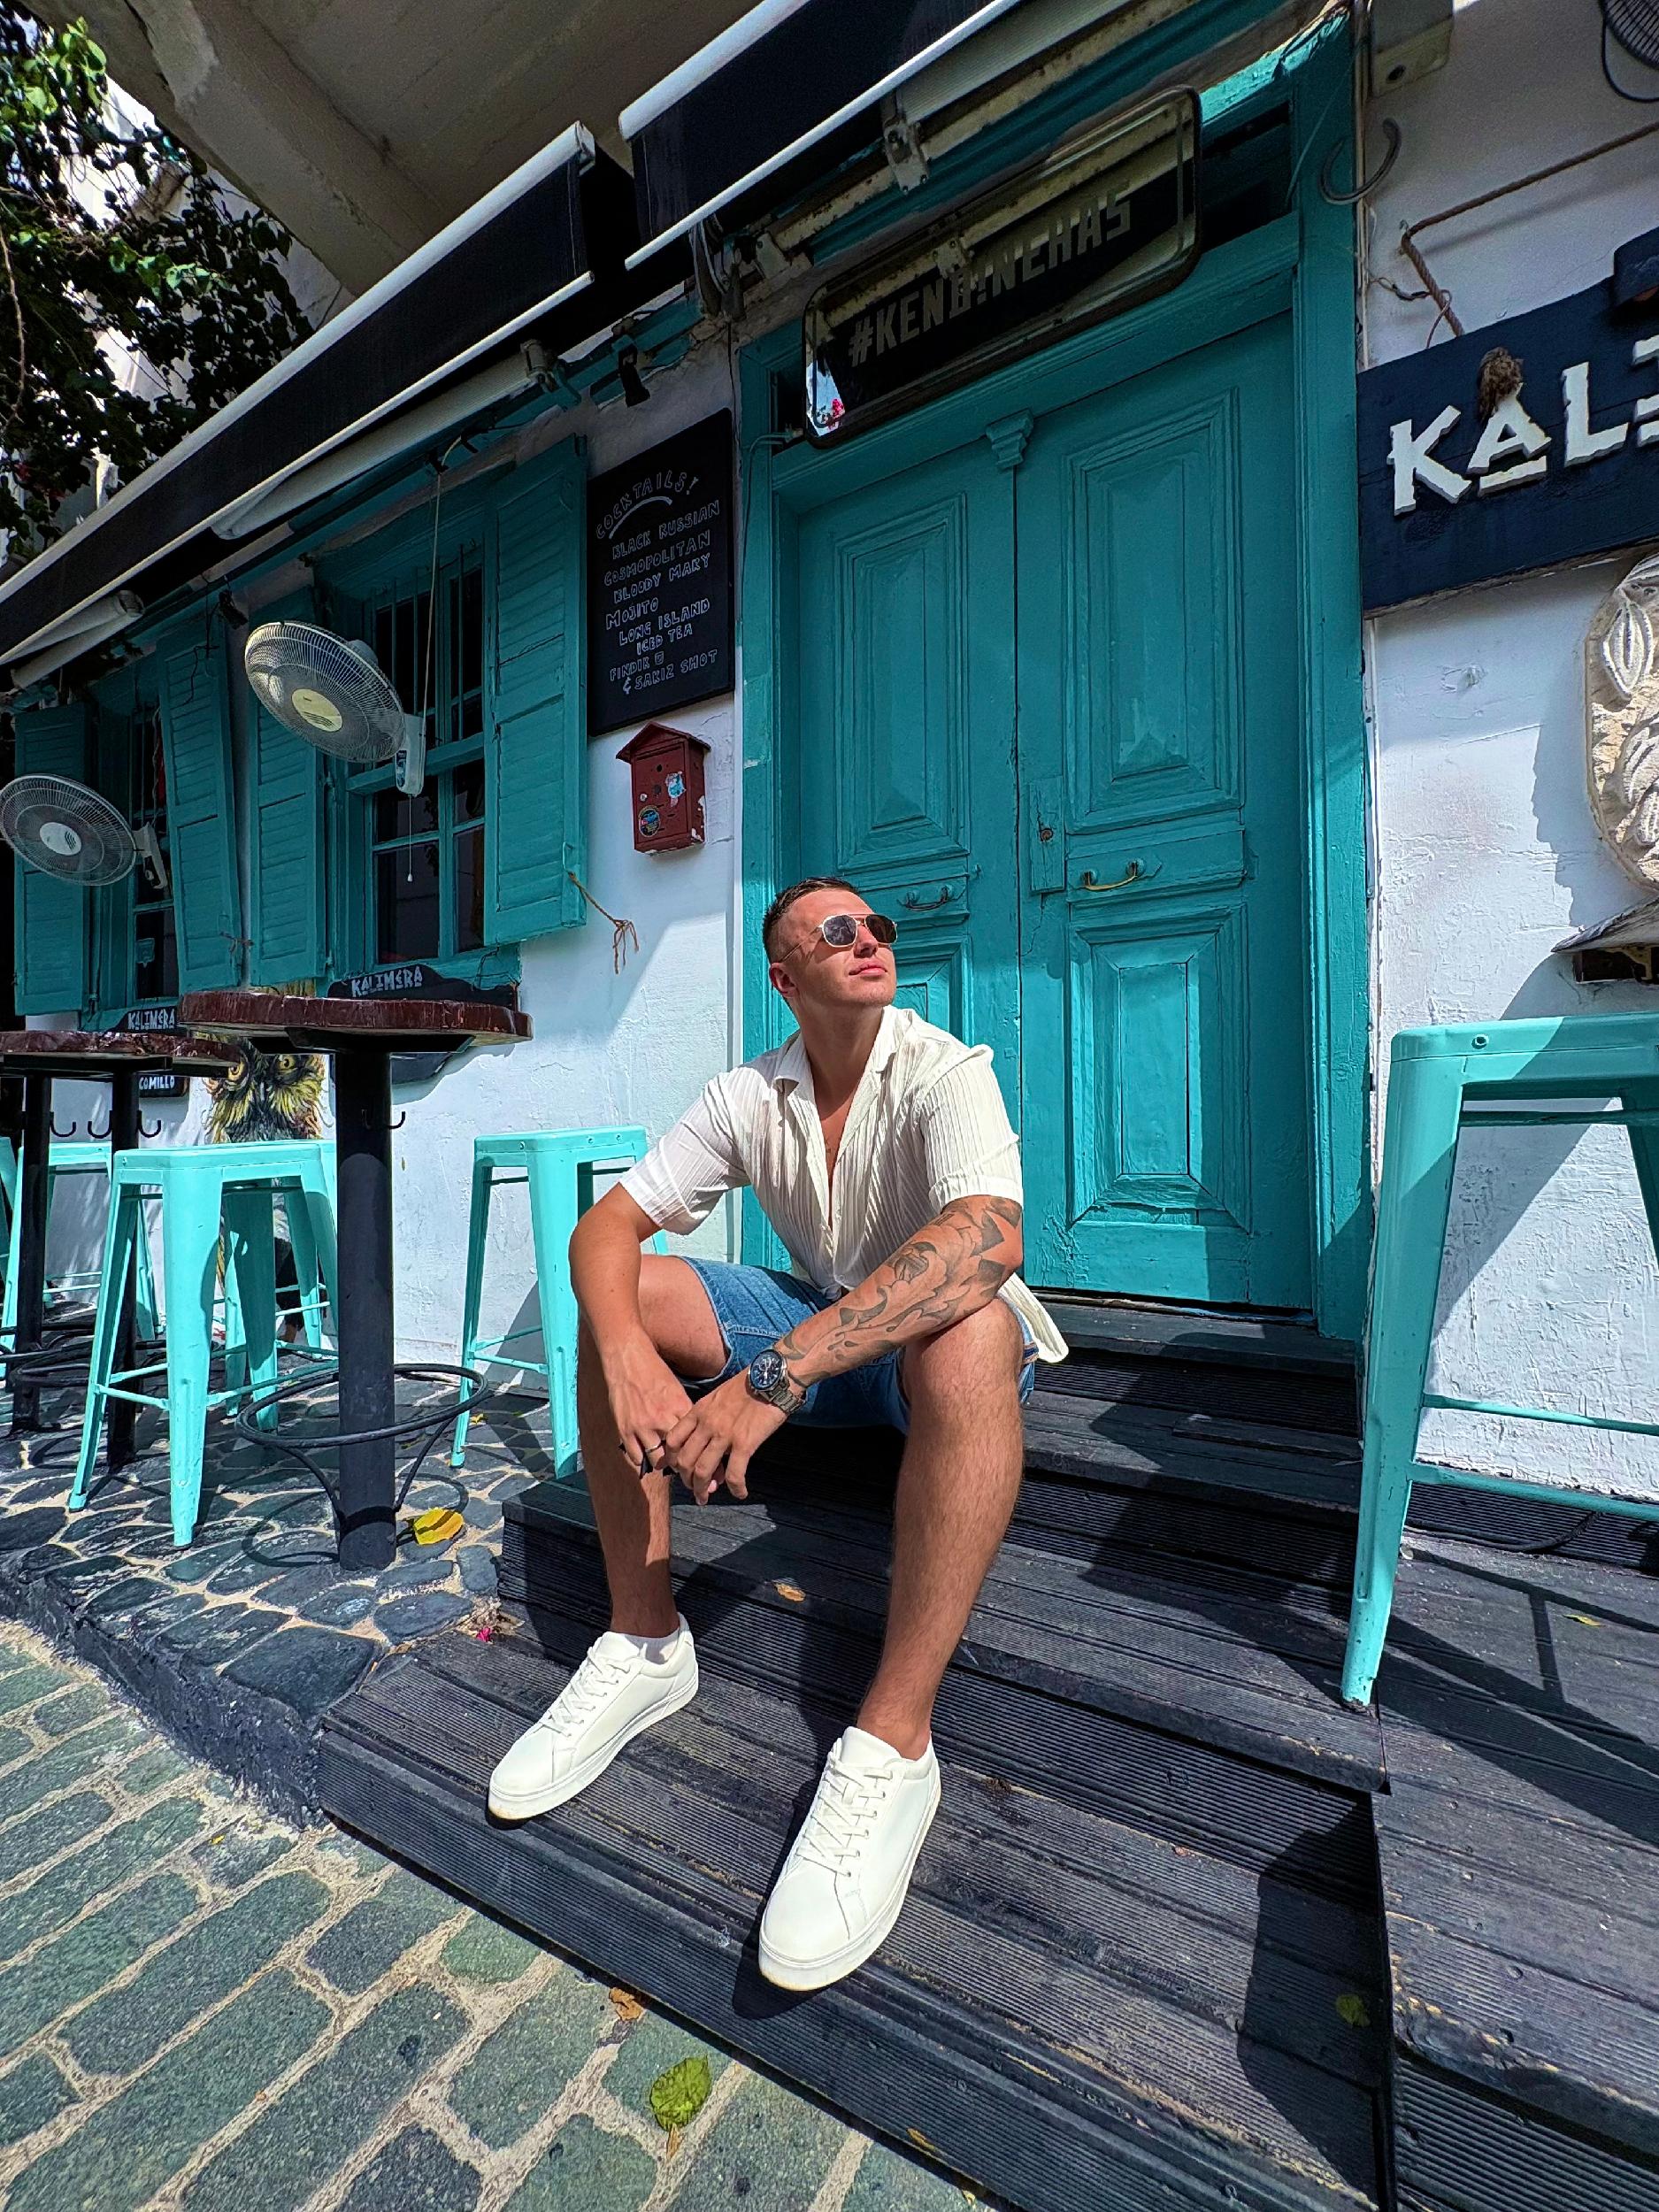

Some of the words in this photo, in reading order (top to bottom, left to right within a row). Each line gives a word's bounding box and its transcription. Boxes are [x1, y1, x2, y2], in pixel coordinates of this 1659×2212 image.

[595, 470, 699, 540] COCKTAILS!
[612, 530, 651, 560] BLACK
[658, 500, 720, 540] RUSSIAN
[604, 529, 710, 587] COSMOPOLITAN
[613, 572, 662, 604] BLOODY
[668, 552, 710, 581] MARY
[619, 621, 651, 646] LONG
[658, 597, 710, 630] ISLAND
[636, 634, 663, 656] ICED
[667, 623, 693, 642] TEA
[634, 664, 674, 690] SAKIZ
[680, 649, 718, 673] SHOT
[351, 965, 423, 997] KALIMERA
[127, 1009, 175, 1030] KALIMERA
